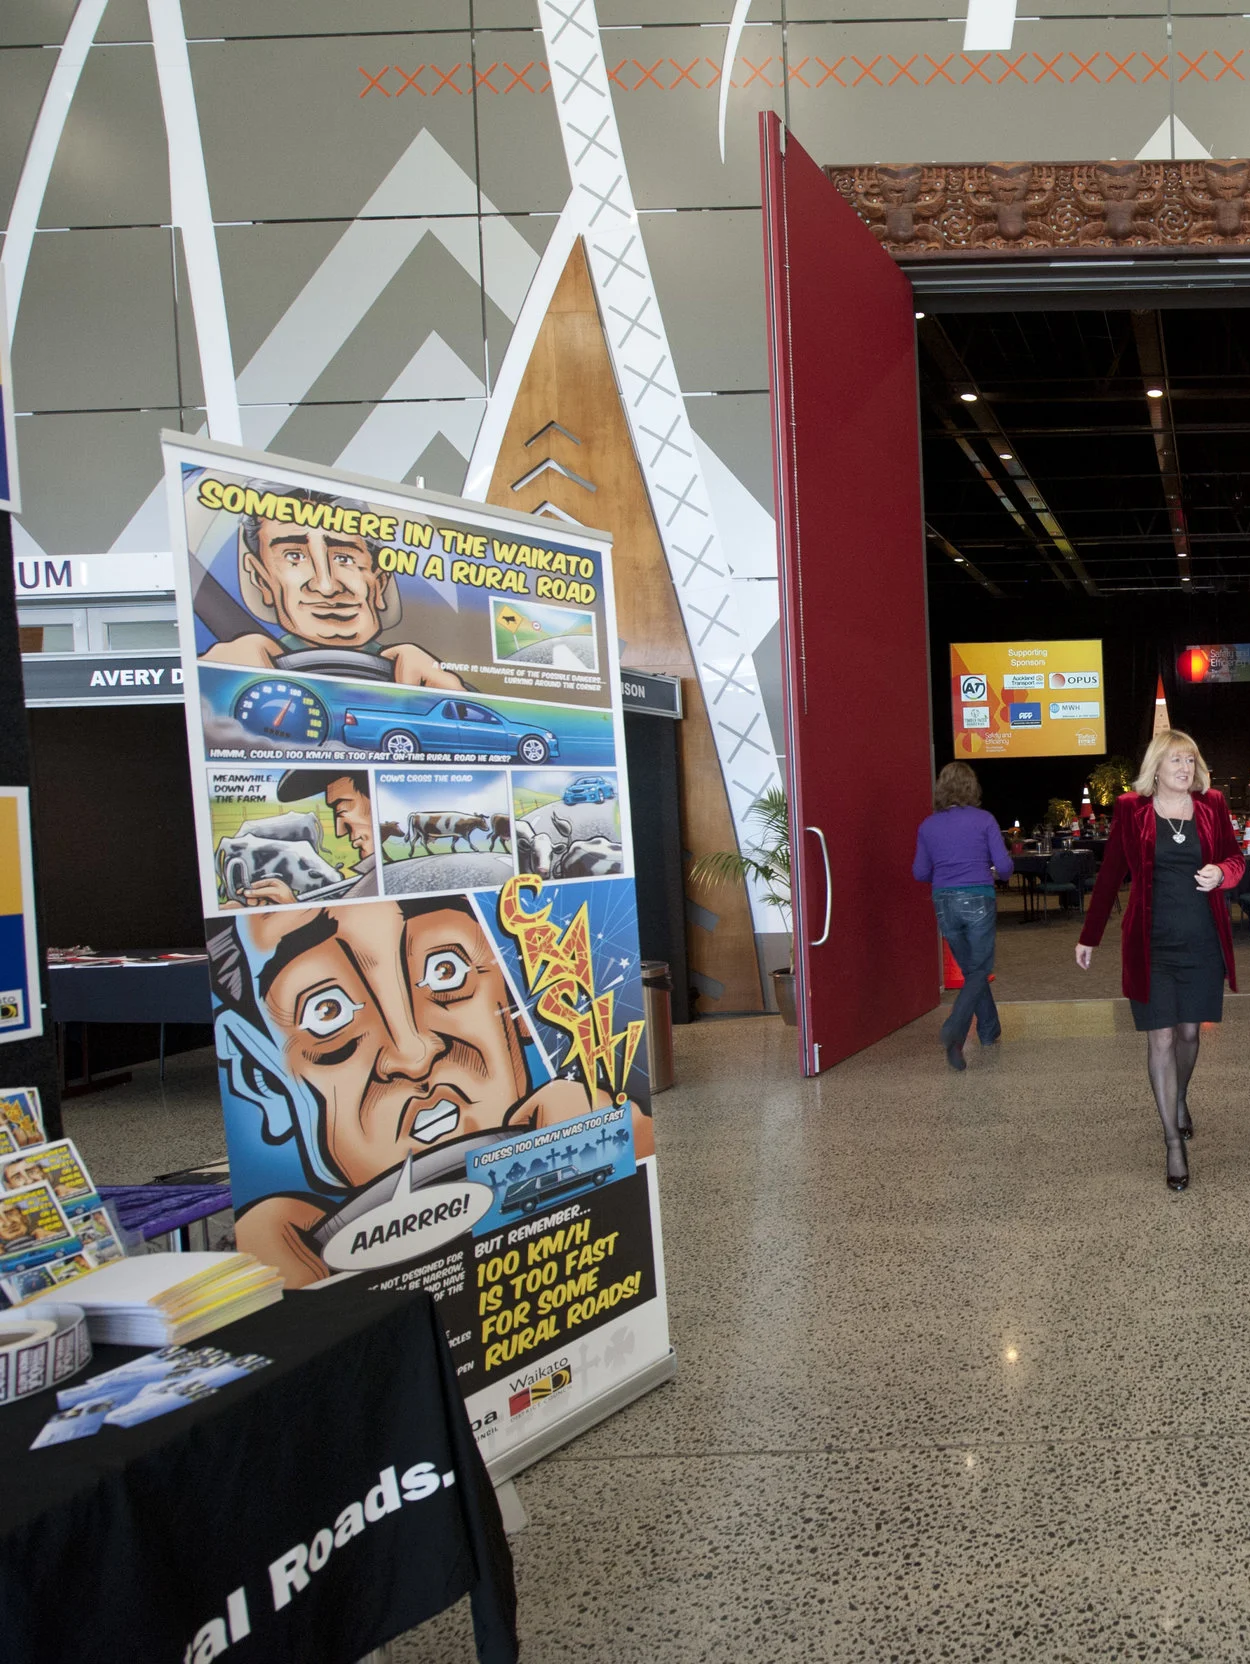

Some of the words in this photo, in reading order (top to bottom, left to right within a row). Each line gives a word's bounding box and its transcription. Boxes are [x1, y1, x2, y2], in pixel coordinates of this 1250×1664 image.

[198, 478, 399, 541] SOMEWHERE
[403, 520, 432, 549] IN
[438, 528, 487, 558] THE
[492, 539, 594, 579] WAIKATO
[378, 546, 418, 576] ON
[423, 555, 445, 581] A
[451, 560, 530, 594] RURAL
[536, 576, 597, 604] ROAD
[1008, 648, 1048, 658] Supporting
[1010, 659, 1046, 667] Sponsors
[90, 668, 165, 687] AVERY
[439, 662, 469, 672] DRIVER
[479, 665, 515, 676] UNAWARE
[527, 670, 540, 678] THE
[541, 671, 570, 681] POSSIBLE
[1067, 676, 1098, 684] OPUS
[504, 676, 533, 686] LURKING
[534, 678, 561, 688] AROUND
[563, 681, 575, 689] THE
[576, 682, 602, 691] CORNER
[210, 748, 247, 760] HMMM,
[250, 749, 283, 759] COULD
[286, 750, 303, 759] 100
[305, 751, 332, 760] KM/H
[333, 751, 345, 760] BE
[348, 752, 366, 760] TOO
[368, 753, 390, 761] FAST
[427, 753, 452, 762] RURAL
[454, 754, 476, 762] ROAD
[478, 754, 488, 762] HE
[488, 755, 512, 763] ASKS?
[380, 774, 405, 782] COWS
[406, 775, 432, 783] CROSS
[434, 775, 449, 783] THE
[450, 775, 473, 783] ROAD
[214, 785, 244, 793] DOWN
[214, 795, 230, 803] THE
[236, 795, 266, 803] FARM
[473, 1156, 479, 1168] I
[480, 1146, 513, 1165] GUESS
[515, 1140, 532, 1155] 100
[534, 1130, 561, 1148] KM/H
[562, 1122, 584, 1138] WAS
[584, 1115, 603, 1130] TOO
[603, 1108, 626, 1124] FAST
[350, 1193, 470, 1255] AAARRRG!
[474, 1234, 504, 1258] BUT
[507, 1204, 591, 1246] REMEMBER...
[477, 1250, 520, 1288] 100
[527, 1218, 591, 1266] KM/H
[380, 1276, 400, 1290] NOT
[401, 1259, 445, 1283] DESIGNED
[446, 1251, 464, 1266] FOR
[443, 1271, 466, 1289] HAVE
[479, 1285, 503, 1316] IS
[509, 1261, 558, 1300] TOO
[565, 1231, 620, 1276] FAST
[408, 1279, 421, 1291] BE
[434, 1290, 446, 1302] OF
[447, 1282, 464, 1296] THE
[481, 1301, 531, 1344] FOR
[537, 1267, 600, 1315] SOME
[484, 1315, 561, 1372] RURAL
[566, 1271, 642, 1329] ROADS!
[509, 1357, 569, 1393] Waikato
[268, 1462, 456, 1612] Roads.
